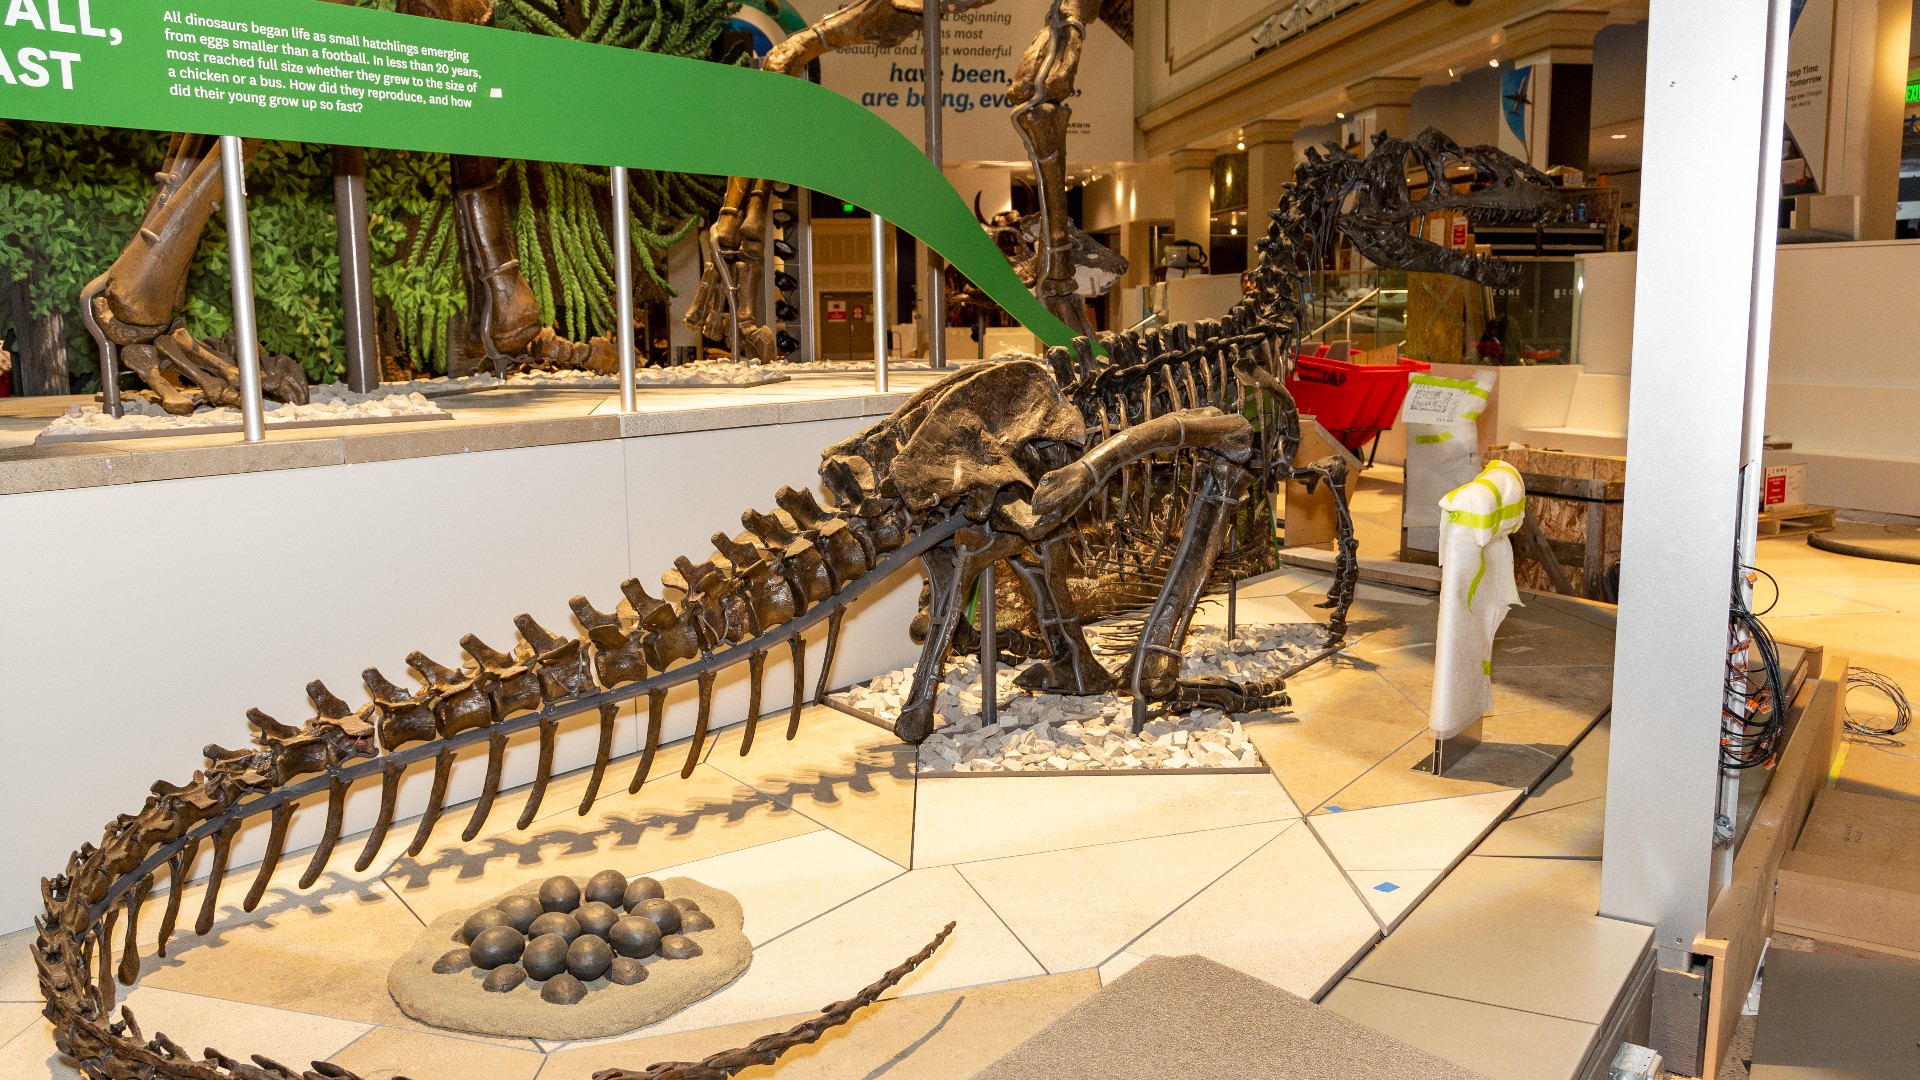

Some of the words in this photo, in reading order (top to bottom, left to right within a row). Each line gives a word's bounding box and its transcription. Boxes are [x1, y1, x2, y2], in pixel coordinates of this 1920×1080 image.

[4, 0, 123, 46] ALL,
[953, 11, 1012, 25] beginning
[163, 10, 182, 24] All
[185, 14, 248, 33] dinosaurs
[251, 21, 289, 39] began
[291, 26, 311, 42] life
[313, 32, 327, 43] as
[329, 34, 361, 48] small
[363, 36, 419, 55] hatchlings
[421, 46, 469, 64] emerging
[954, 29, 984, 39] most
[164, 28, 196, 44] from
[200, 35, 230, 50] eggs
[232, 36, 279, 54] smaller
[281, 43, 309, 58] than
[311, 49, 320, 59] a
[322, 47, 370, 65] football.
[373, 55, 384, 66] In
[386, 56, 407, 70] less
[409, 59, 434, 73] than
[436, 63, 450, 75] 20
[451, 66, 482, 80] years,
[894, 44, 917, 55] and
[952, 44, 1012, 58] wonderful
[166, 49, 201, 63] most
[203, 52, 255, 69] reached
[257, 56, 279, 72] full
[281, 60, 304, 74] size
[306, 63, 354, 80] whether
[356, 69, 381, 85] they
[383, 75, 410, 87] grew
[412, 75, 424, 88] to
[426, 77, 443, 90] the
[445, 80, 465, 92] size
[467, 81, 478, 93] of
[889, 62, 944, 83] hav
[952, 62, 1013, 87] been,
[1803, 64, 1819, 75] Time
[168, 67, 177, 78] a
[179, 66, 229, 83] chicken
[232, 74, 247, 85] or
[249, 75, 258, 86] a
[260, 75, 287, 89] bus.
[289, 79, 316, 93] How
[318, 80, 338, 95] did
[340, 83, 365, 100] they
[367, 87, 427, 104] reproduce,
[429, 94, 449, 106] and
[451, 96, 473, 109] how
[1789, 75, 1822, 88] Tomorrow
[169, 83, 191, 97] did
[193, 86, 226, 101] their
[228, 91, 267, 108] young
[269, 95, 299, 109] grow
[302, 98, 318, 112] up
[320, 100, 334, 111] so
[336, 100, 364, 114] fast?
[861, 91, 899, 108] are
[1492, 288, 1520, 296] ZONE
